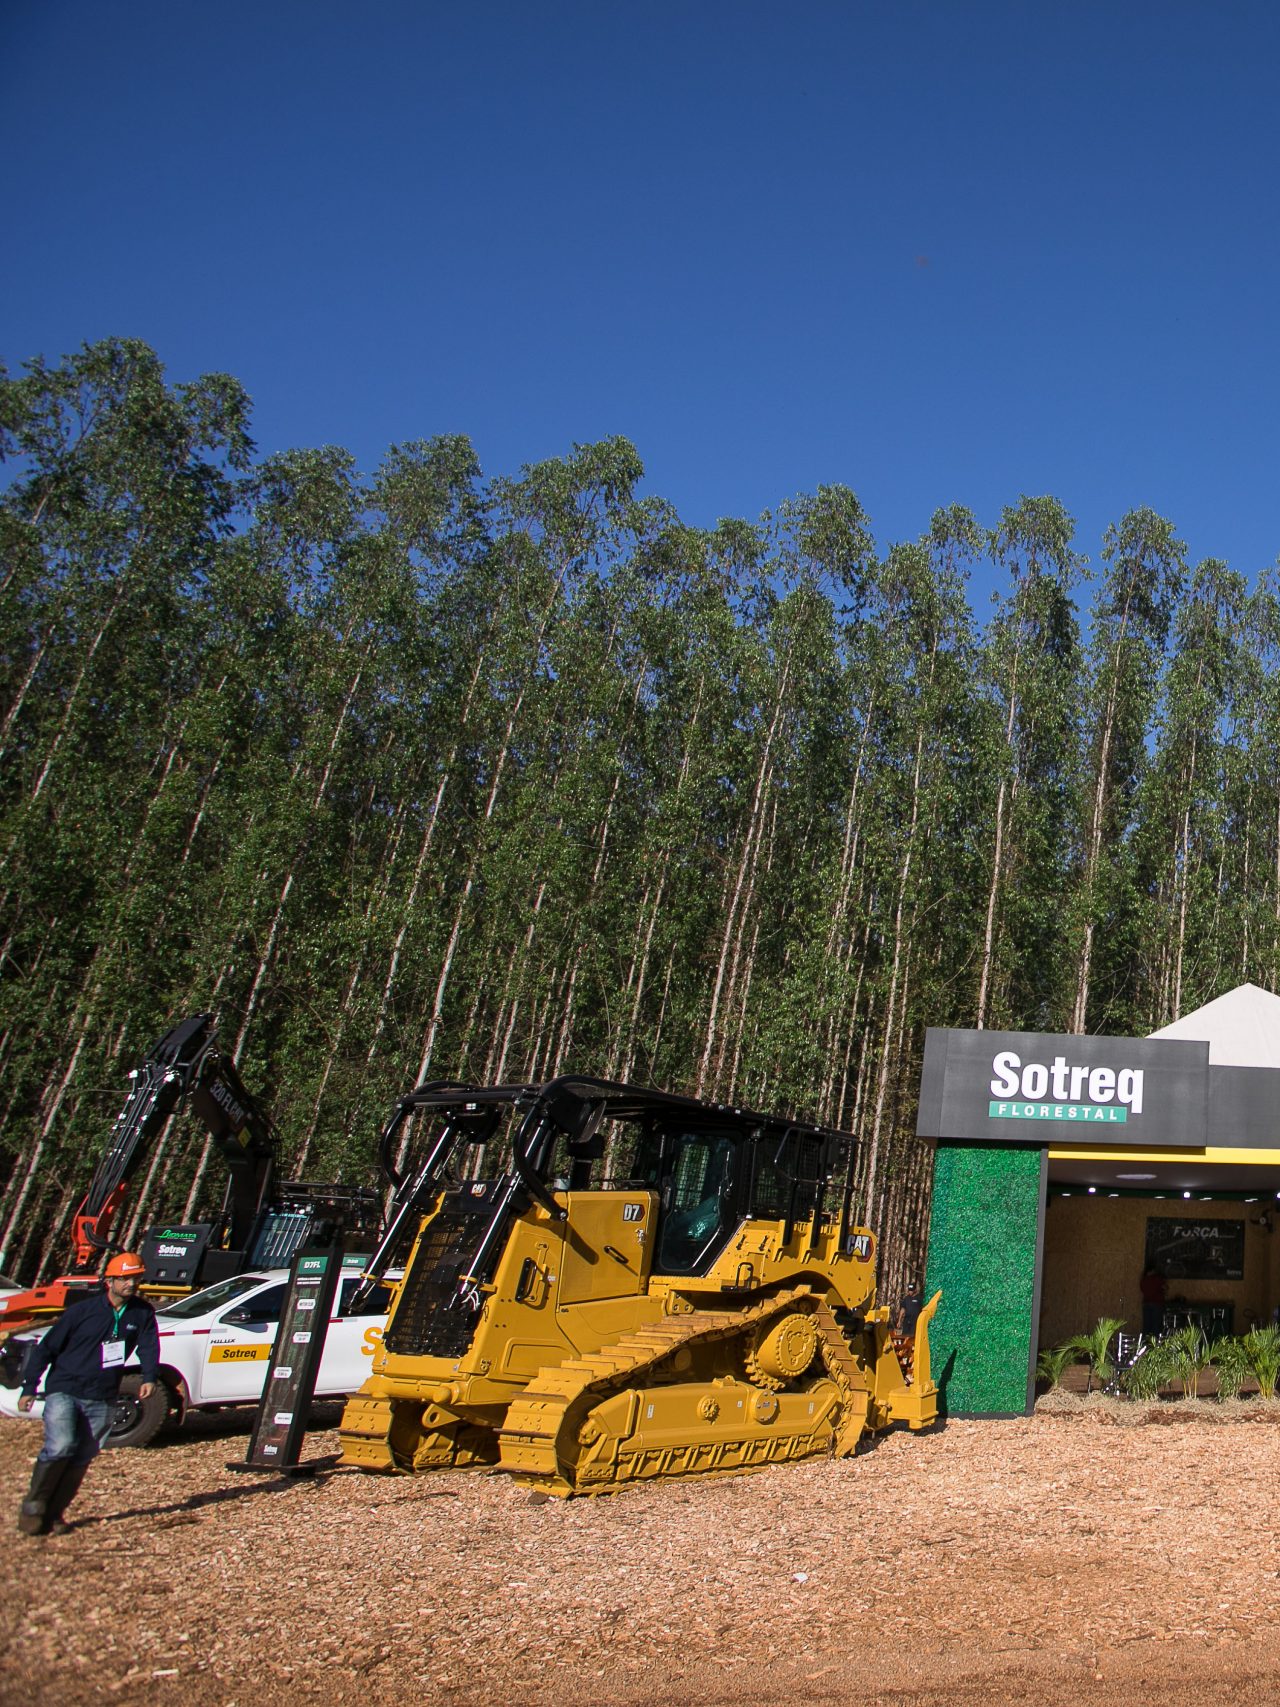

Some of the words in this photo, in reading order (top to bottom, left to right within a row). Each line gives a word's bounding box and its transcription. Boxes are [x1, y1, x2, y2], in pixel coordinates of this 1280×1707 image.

[990, 1051, 1144, 1114] Sotreq
[998, 1104, 1117, 1120] FLORESTAL
[623, 1204, 639, 1221] D7
[158, 1244, 187, 1256] Sotreq
[847, 1234, 869, 1257] CAT
[222, 1349, 257, 1359] Sotreq
